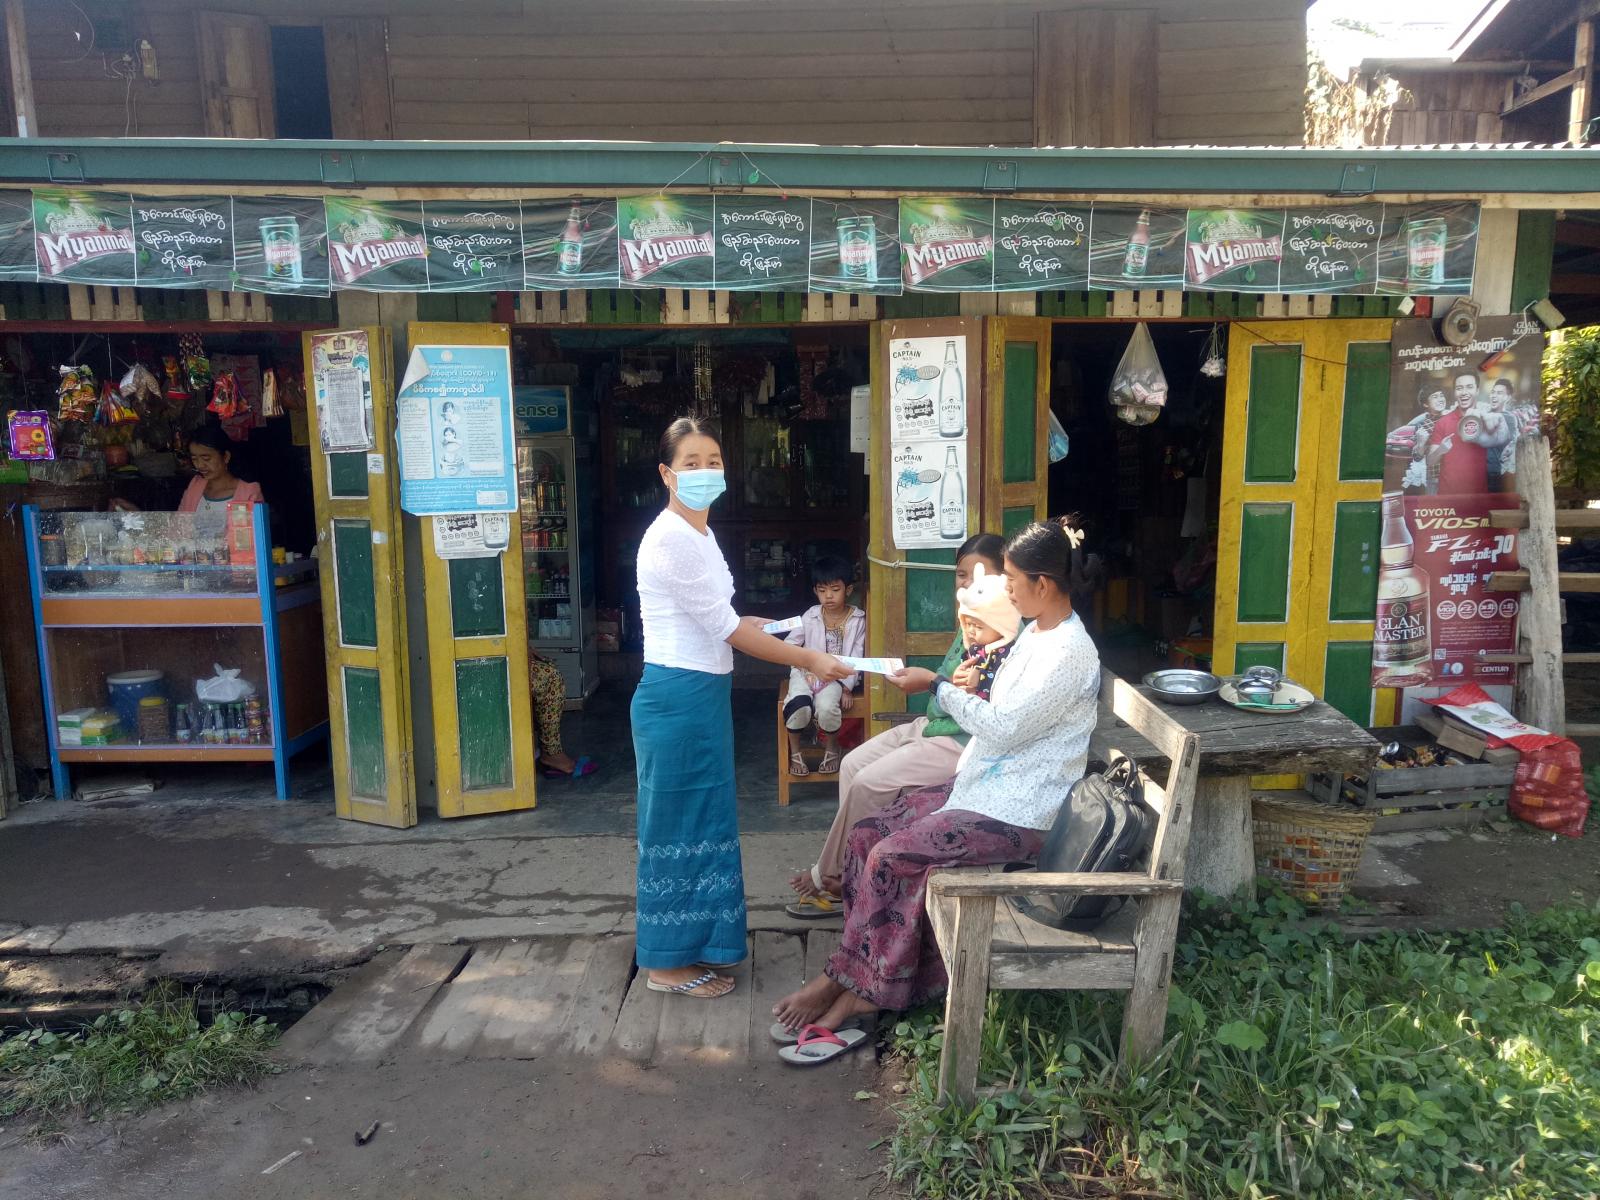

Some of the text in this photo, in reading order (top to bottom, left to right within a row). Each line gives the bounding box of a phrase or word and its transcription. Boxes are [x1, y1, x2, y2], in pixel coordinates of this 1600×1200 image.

[40, 232, 130, 265] Myanmar
[623, 236, 711, 272] Myanmar
[333, 240, 424, 274] Myanmar
[904, 240, 990, 277] Myanmar
[1190, 241, 1279, 276] Myanmar
[893, 350, 921, 359] CAPTAIN
[515, 404, 558, 418] ense
[1413, 508, 1456, 517] TOYOTA
[1414, 517, 1481, 530] VIOS
[1379, 613, 1421, 631] GLAN
[1375, 626, 1426, 641] MASTER
[1481, 665, 1510, 673] CENTURY
